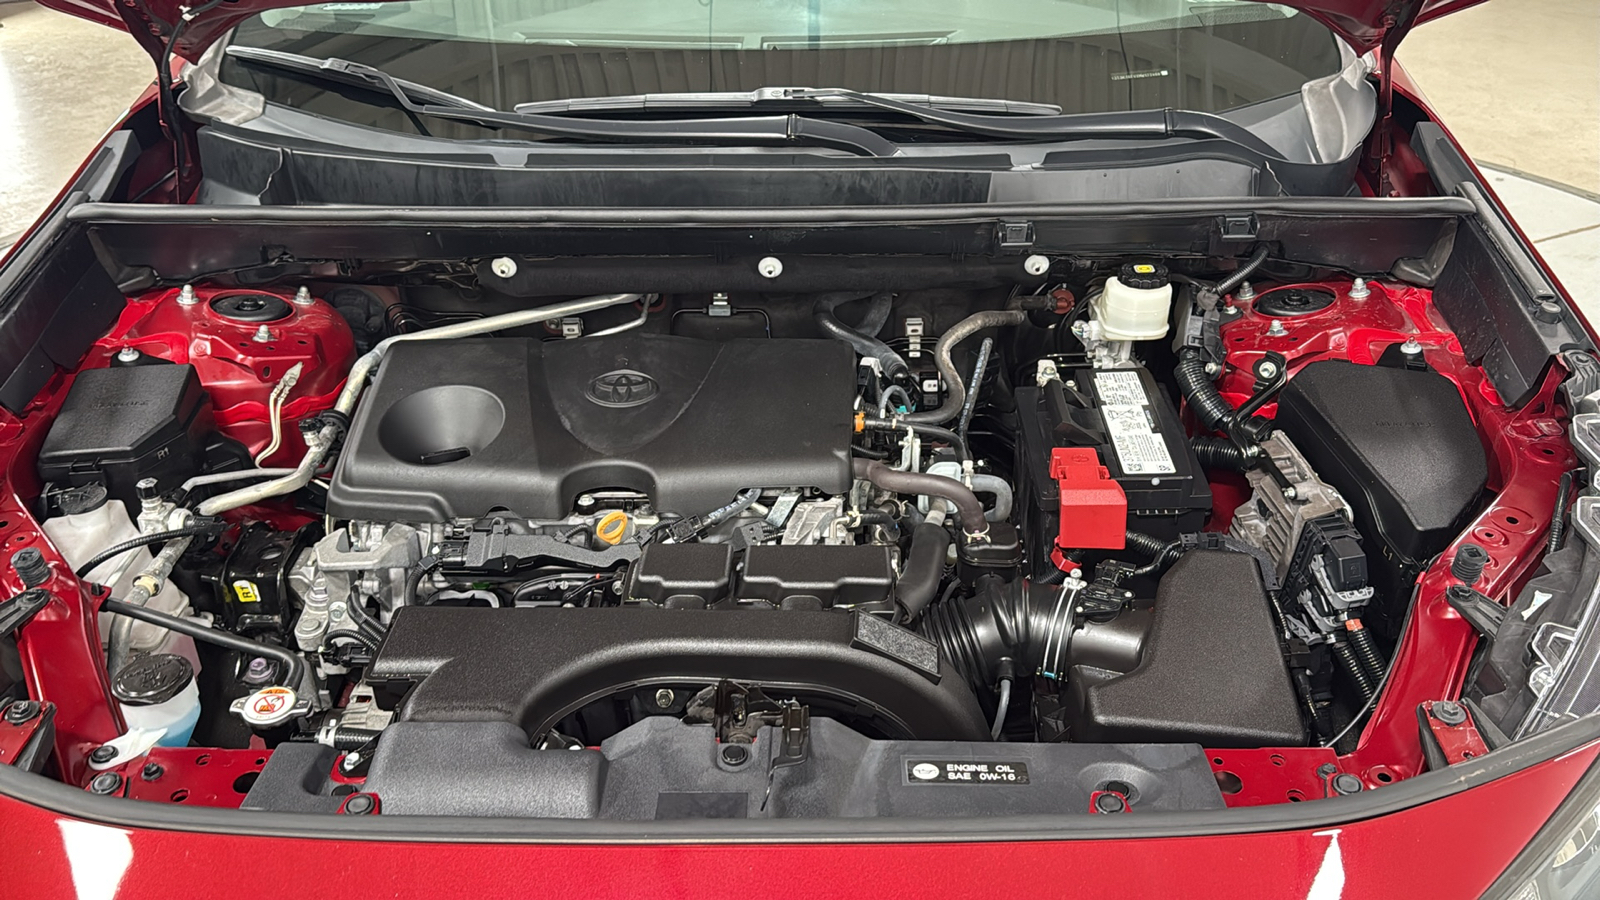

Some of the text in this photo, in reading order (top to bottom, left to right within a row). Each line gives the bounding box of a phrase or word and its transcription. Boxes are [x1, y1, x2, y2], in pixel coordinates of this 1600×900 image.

[1382, 545, 1393, 561] L1
[946, 763, 1015, 773] ENGINE OIL
[947, 772, 1016, 781] SAE 0W-16
